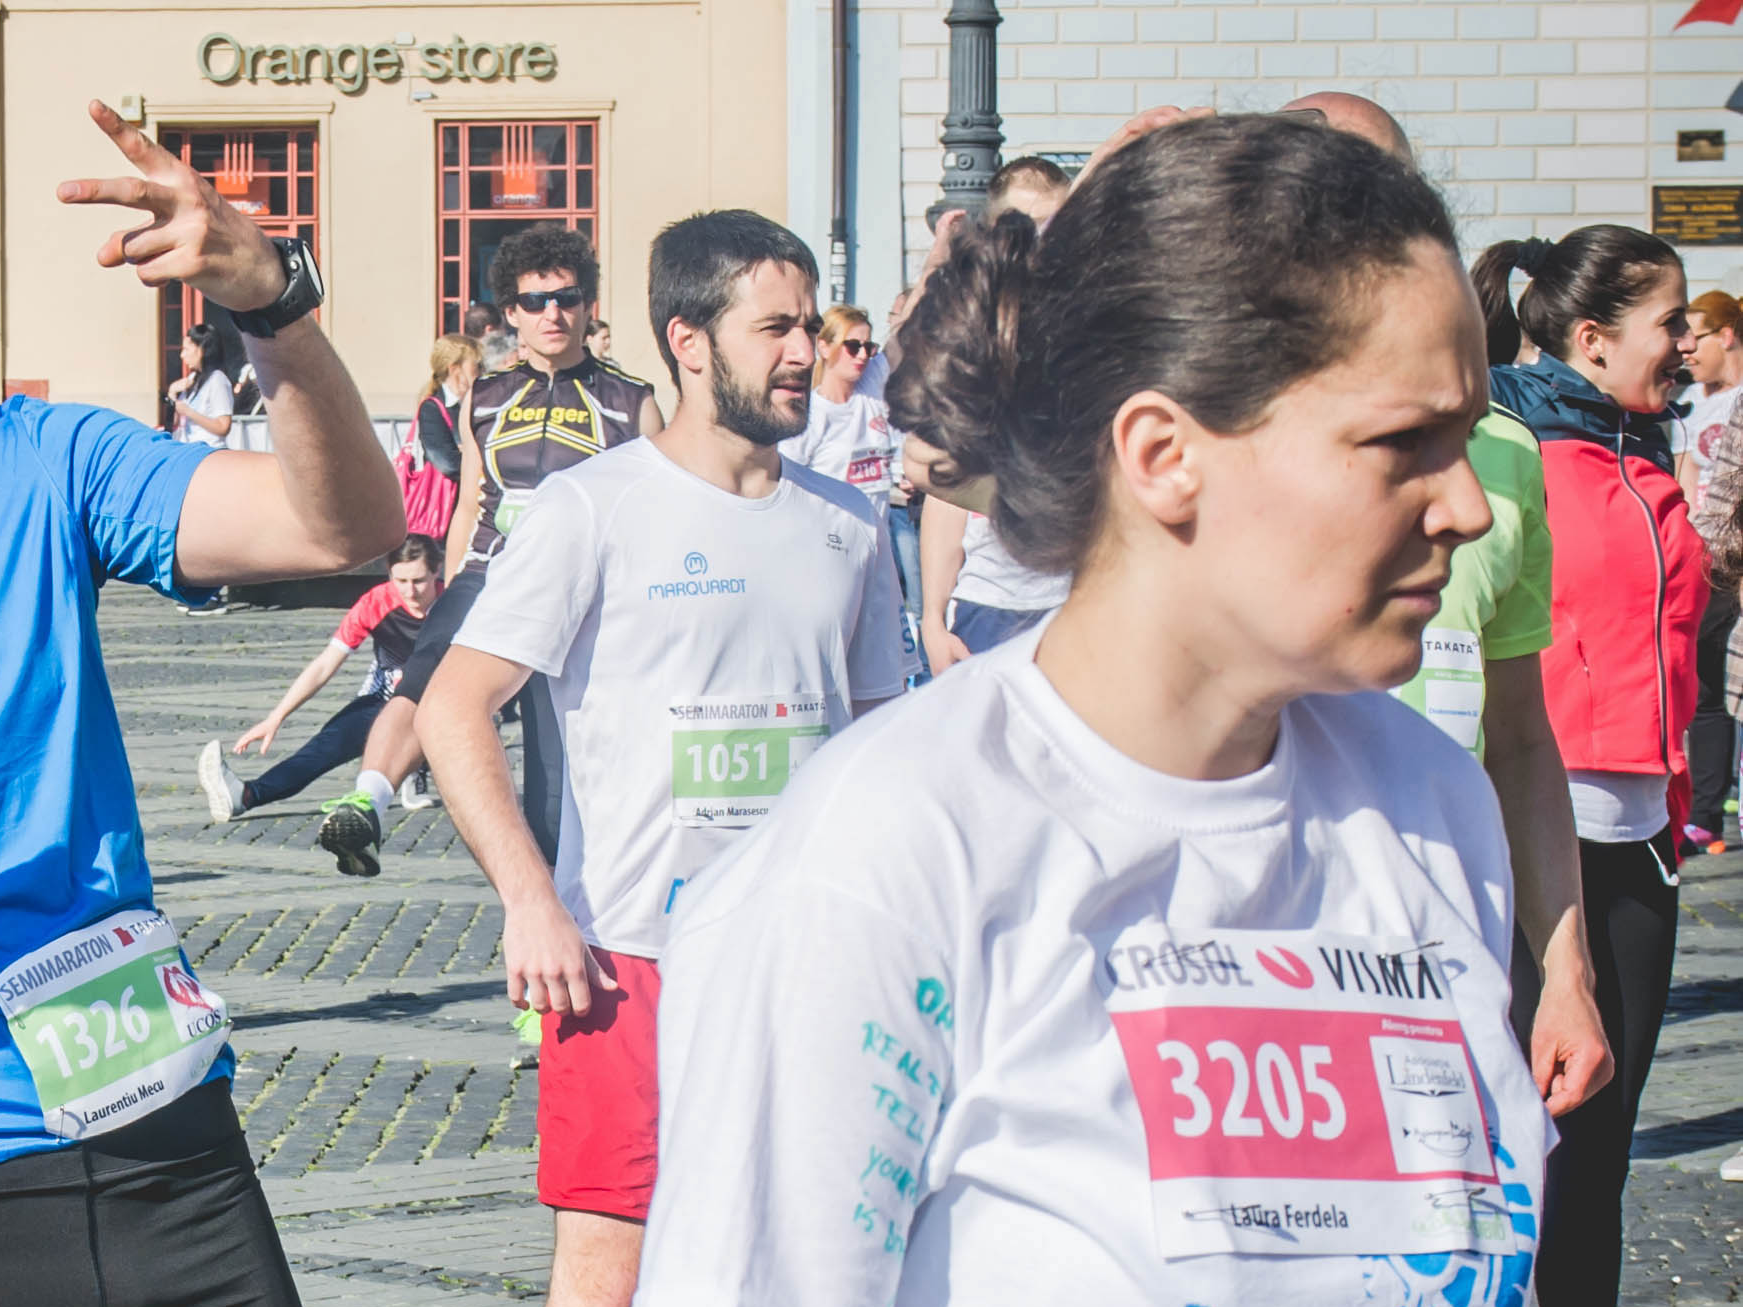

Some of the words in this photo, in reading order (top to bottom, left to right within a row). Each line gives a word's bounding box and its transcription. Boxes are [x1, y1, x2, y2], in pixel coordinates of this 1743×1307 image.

[197, 32, 403, 95] Orange
[419, 34, 557, 81] store
[648, 578, 746, 600] MARQUARDT
[1425, 641, 1474, 654] TAKATA
[677, 704, 768, 720] SEMIMARATON
[686, 742, 768, 783] 1051
[696, 807, 724, 817] Adrian
[0, 934, 114, 1001] SEMIMARATON
[1106, 942, 1253, 992] CROSUL
[1318, 947, 1444, 1000] VISMA
[36, 985, 151, 1079] 1326
[187, 1010, 222, 1038] UCOS
[84, 1092, 138, 1124] Laurentiu
[139, 1079, 165, 1101] Mecu
[1157, 1040, 1347, 1140] 3205
[1231, 1205, 1280, 1229] Laura
[1284, 1204, 1349, 1229] Ferdela
